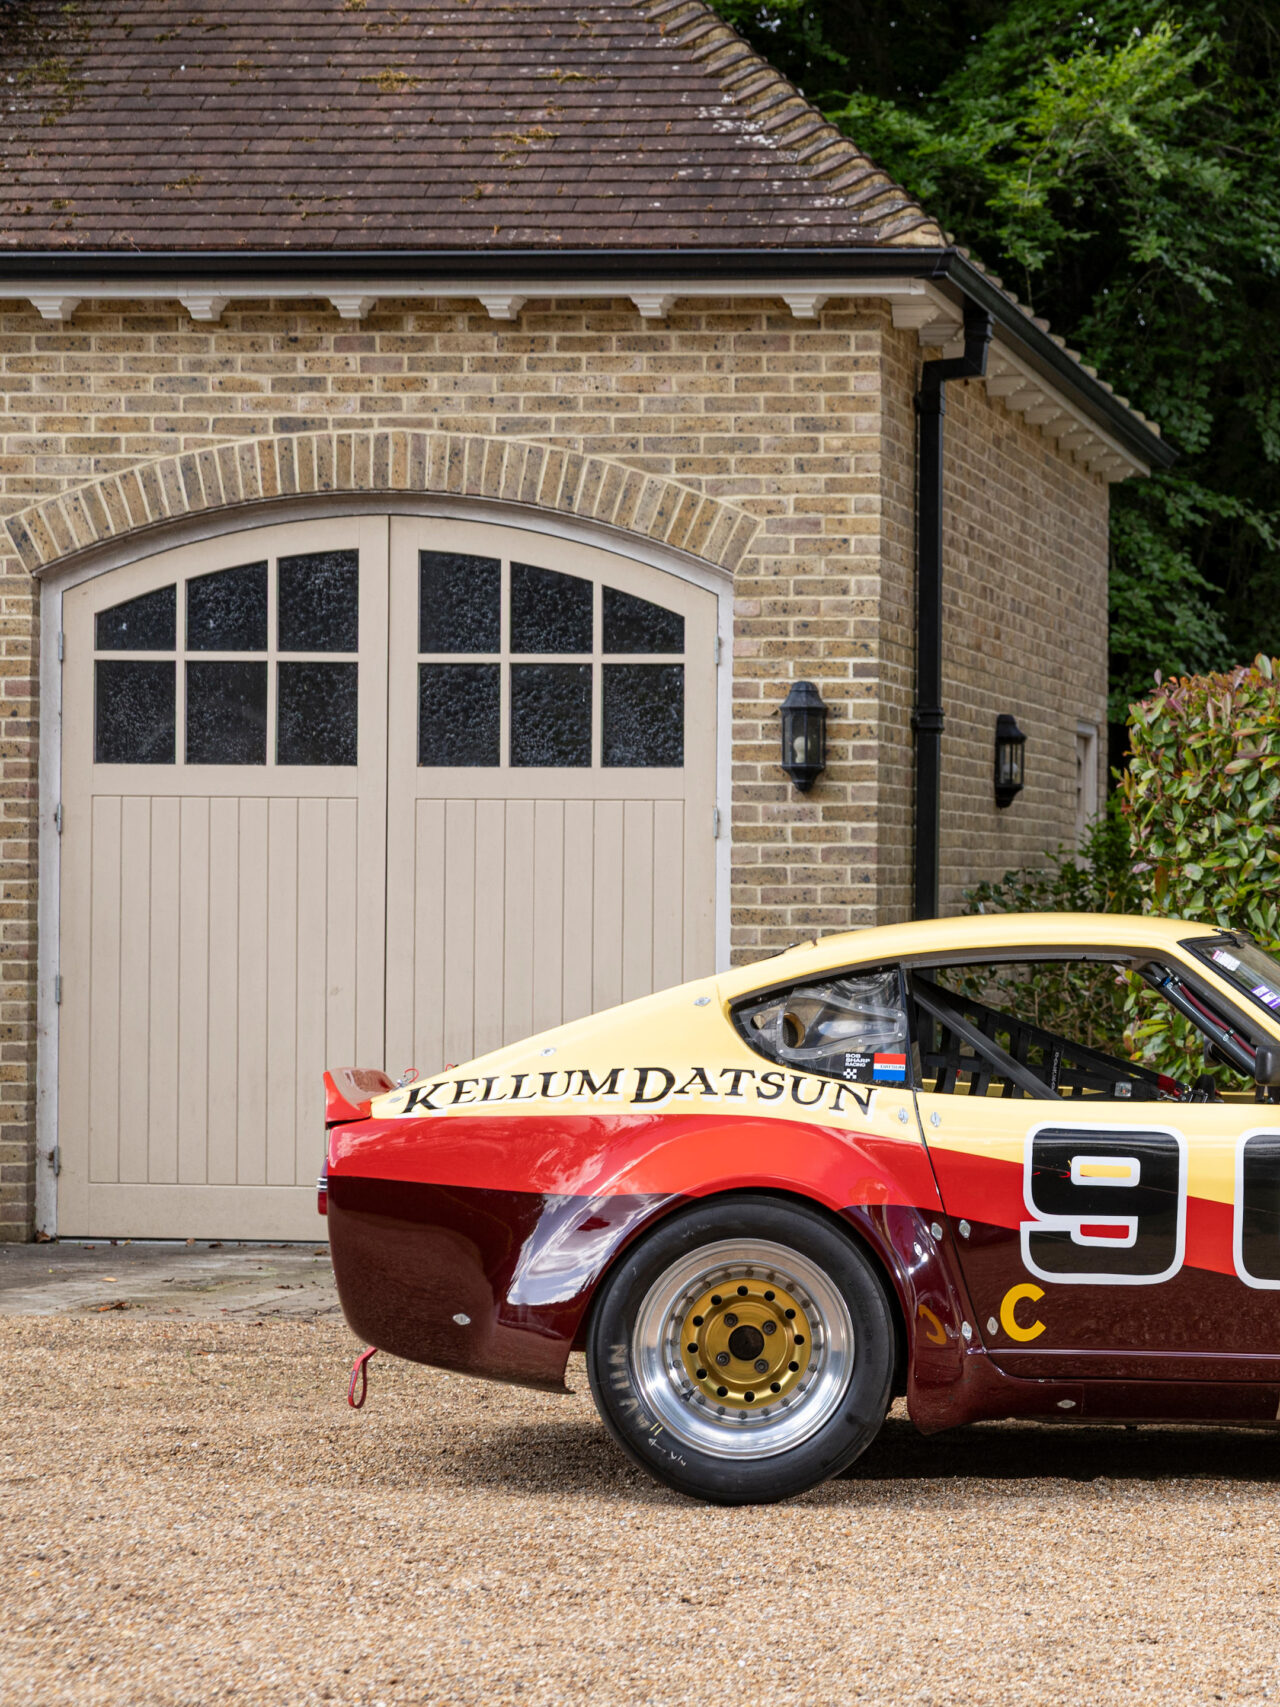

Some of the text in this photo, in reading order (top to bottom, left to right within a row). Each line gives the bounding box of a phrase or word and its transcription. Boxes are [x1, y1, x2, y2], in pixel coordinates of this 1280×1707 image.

[401, 1067, 877, 1115] KELLUM DATSUN
[1000, 1283, 1047, 1342] C
